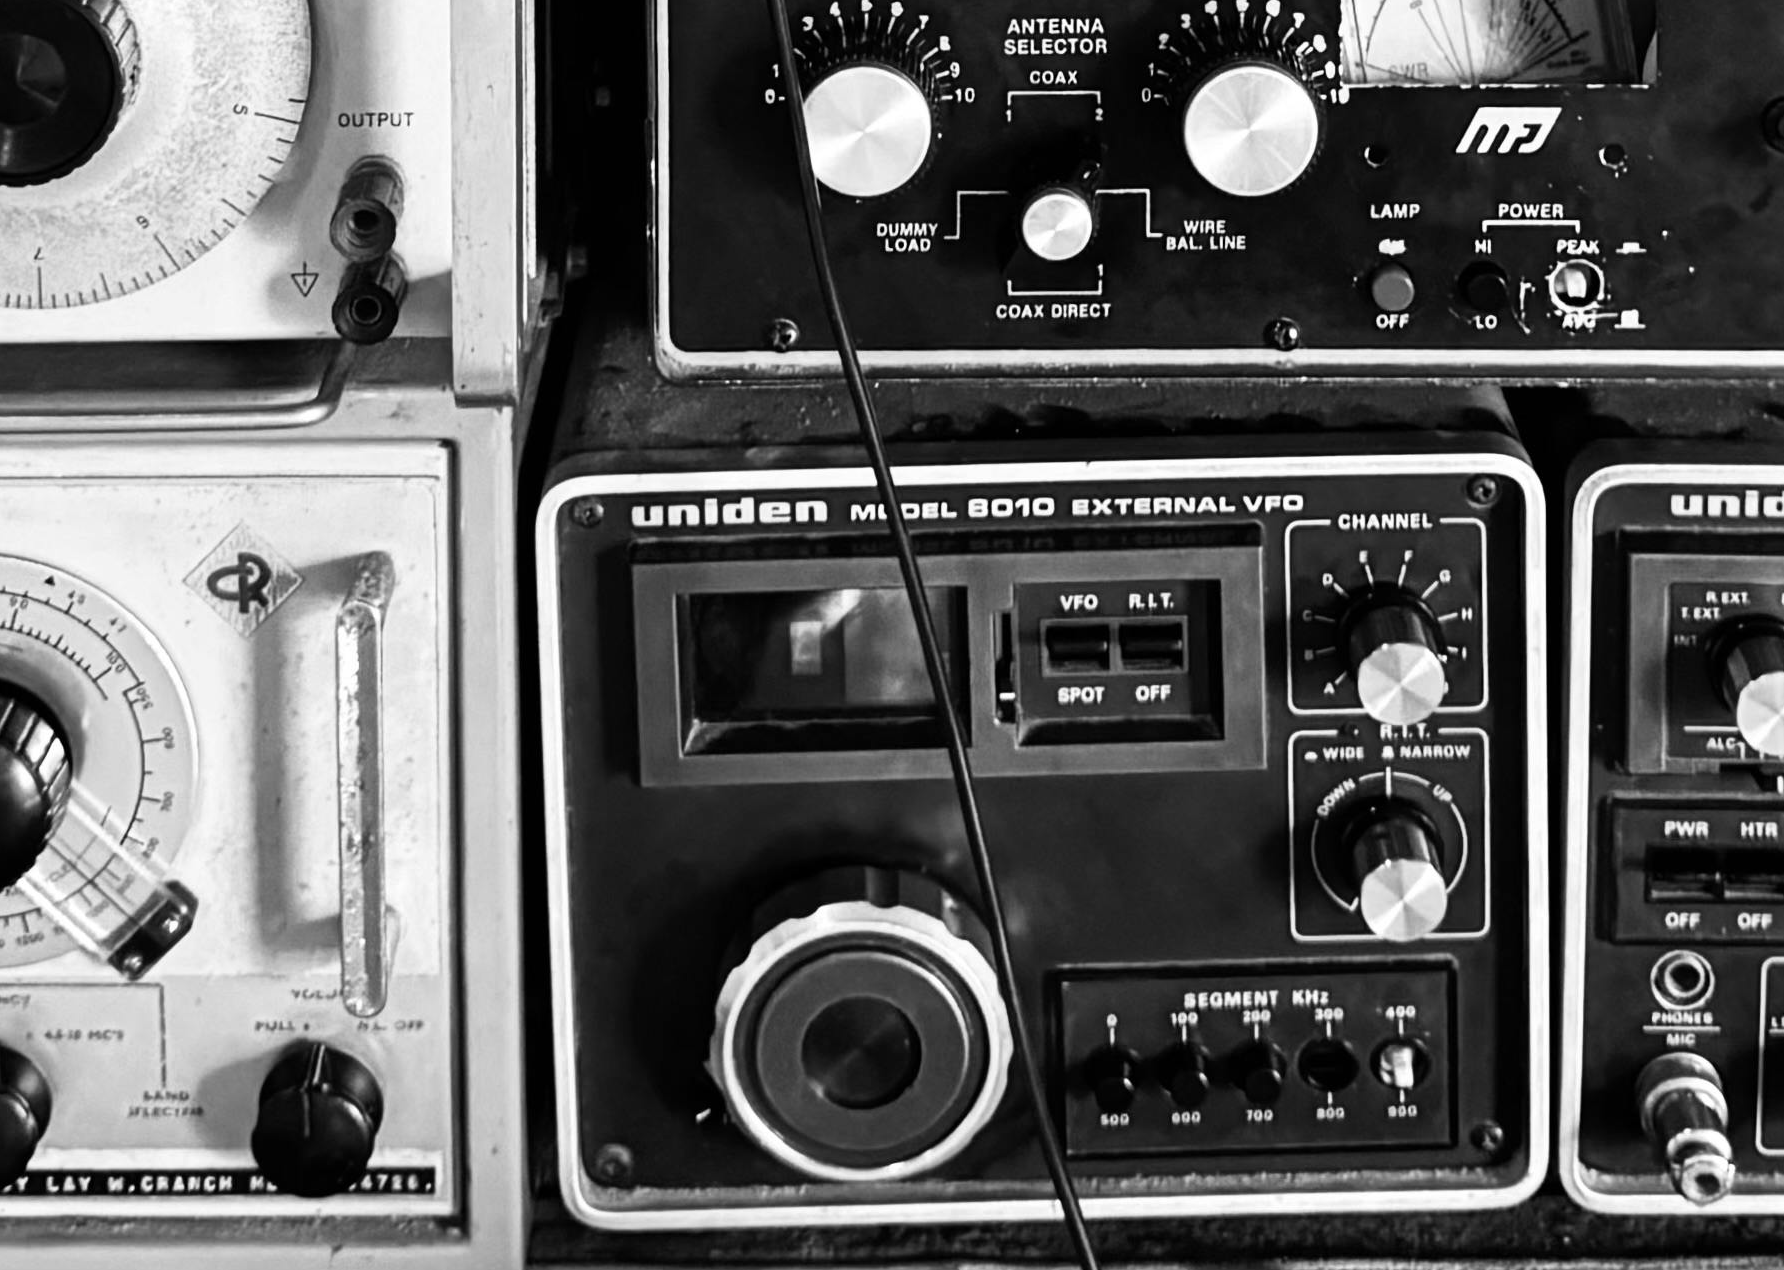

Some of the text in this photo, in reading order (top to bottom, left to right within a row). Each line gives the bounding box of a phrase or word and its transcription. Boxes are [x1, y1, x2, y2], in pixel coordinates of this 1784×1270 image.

[1008, 18, 1103, 34] ANTENNA
[1005, 38, 1107, 54] SELECTOR
[1030, 71, 1077, 84] COAX
[337, 111, 415, 130] OUTPUT
[1371, 204, 1420, 218] LAMP
[1499, 204, 1563, 218] POWER
[877, 223, 937, 236] DUMMY
[885, 238, 930, 252] LOAD
[996, 304, 1111, 318] COAX DIRECT
[632, 495, 1303, 526] uniden MDEL 8010 EXTERNAL VFO
[1338, 513, 1432, 529] CHANNEL
[1058, 687, 1104, 703] SPOT
[1185, 991, 1278, 1008] SEGMENT
